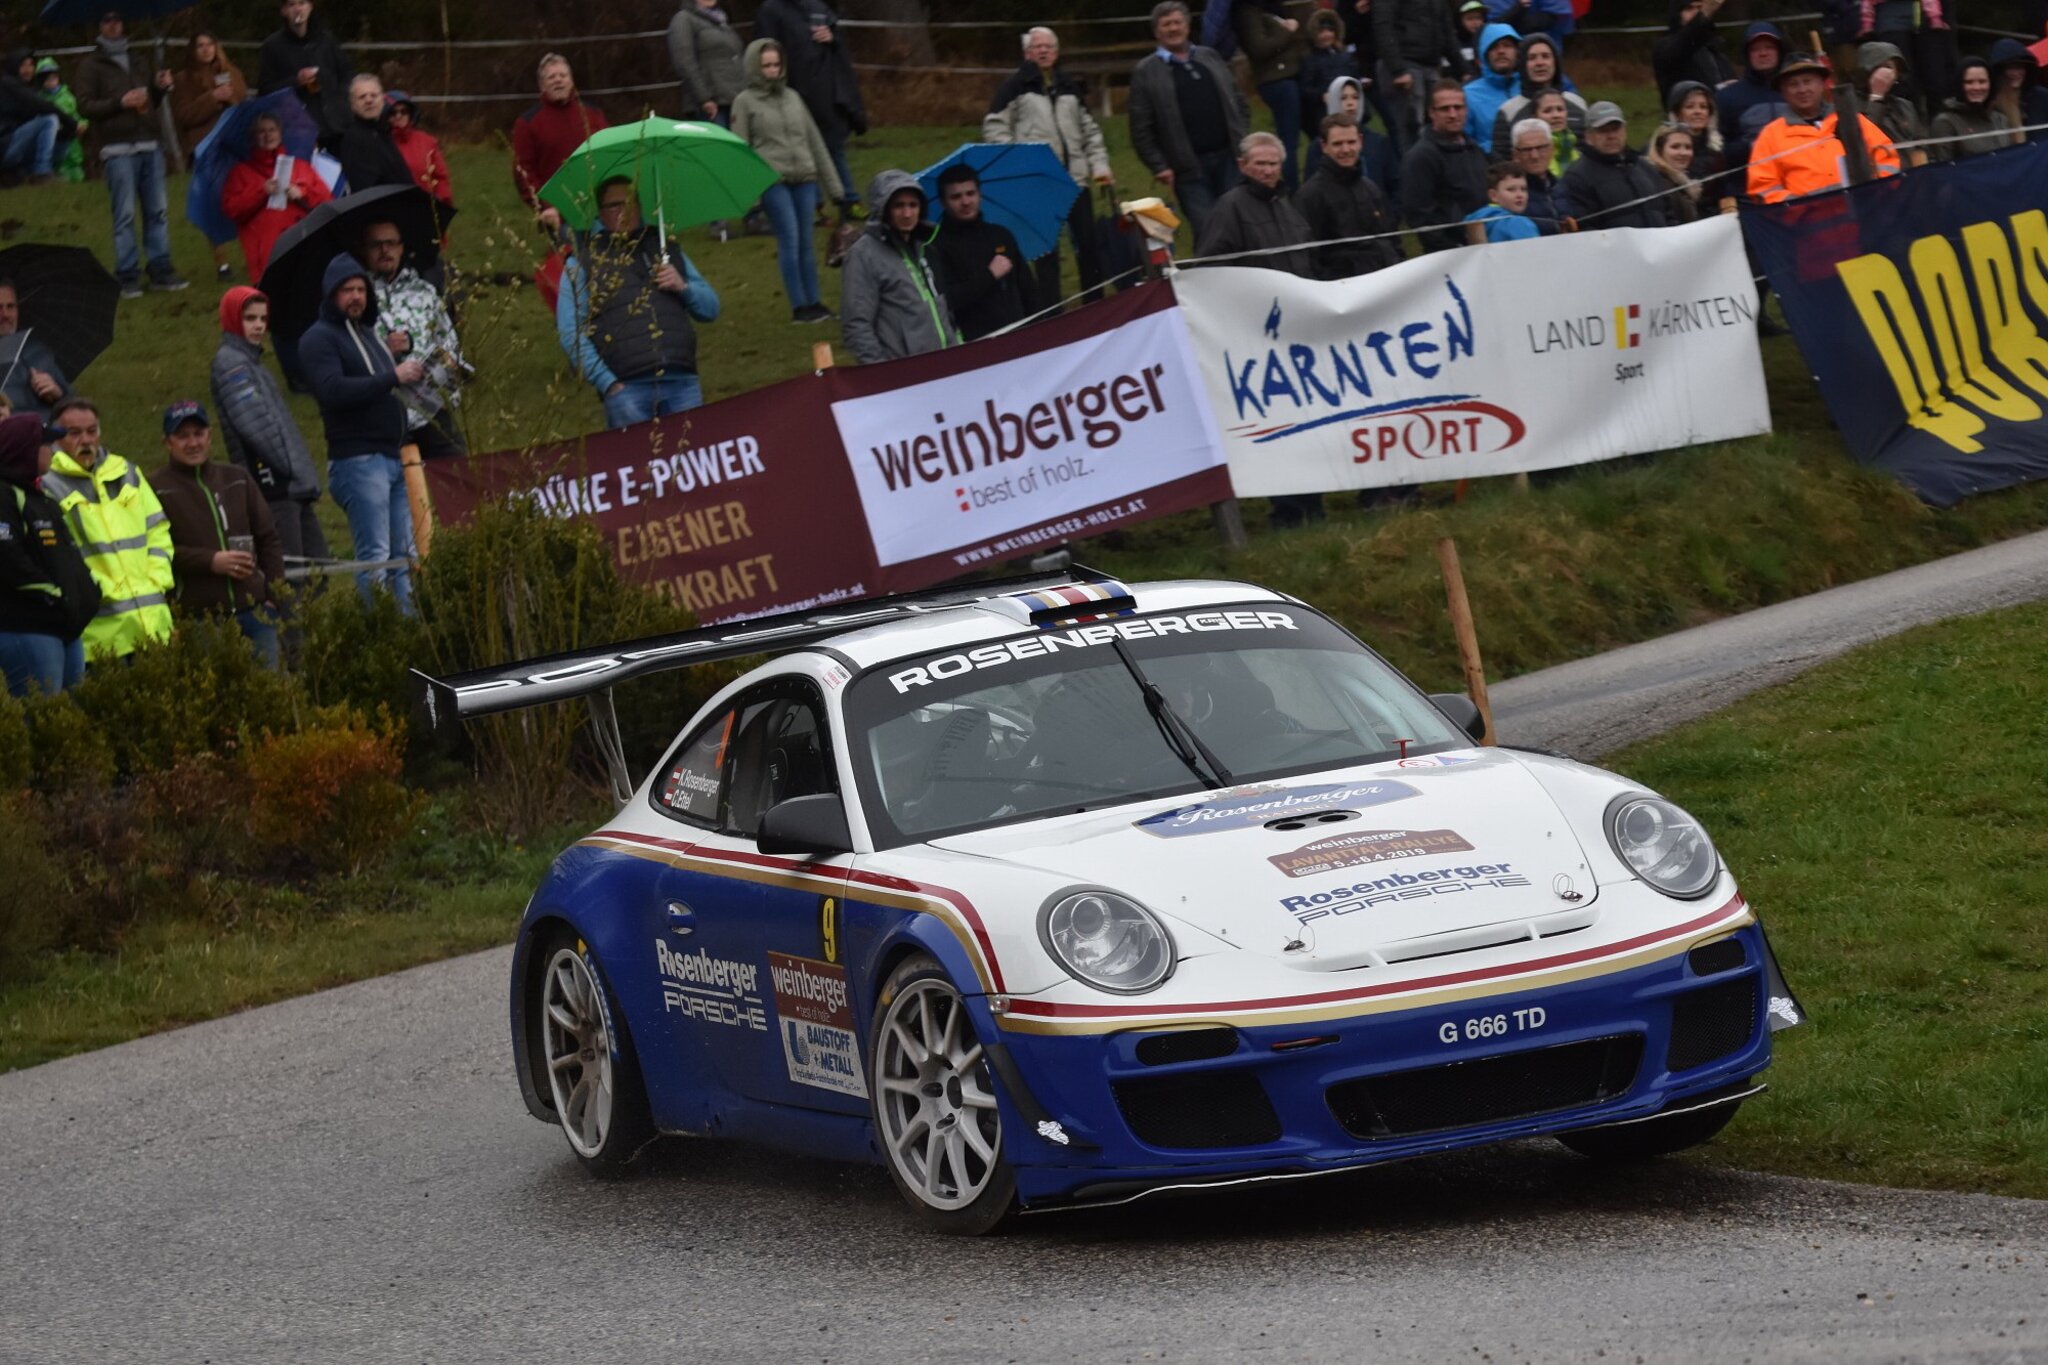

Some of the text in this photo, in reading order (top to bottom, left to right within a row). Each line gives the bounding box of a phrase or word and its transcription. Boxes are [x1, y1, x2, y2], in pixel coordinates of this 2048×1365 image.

[1527, 316, 1606, 354] LAND
[1615, 362, 1645, 384] Sport
[871, 363, 1167, 491] weinberger
[1352, 409, 1483, 464] SPORT
[618, 436, 765, 506] E-POWER
[970, 479, 1016, 508] best
[1018, 467, 1037, 494] of
[617, 501, 752, 566] EIGENER
[953, 499, 1147, 567] WWW.WEINBERGER-HOLZ.AT
[888, 611, 1300, 694] ROSENBERGER
[1172, 784, 1384, 827] Rosenberger
[1306, 831, 1407, 851] weinberger
[1280, 861, 1512, 912] Rosenberger
[1297, 877, 1532, 926] PORSCHE
[822, 898, 836, 963] 9
[664, 991, 768, 1031] PORSCHE
[770, 960, 847, 1013] weinberger
[806, 1025, 850, 1053] BAUSTOFF
[1439, 1007, 1546, 1044] G 666 TD
[820, 1051, 854, 1077] METALL
